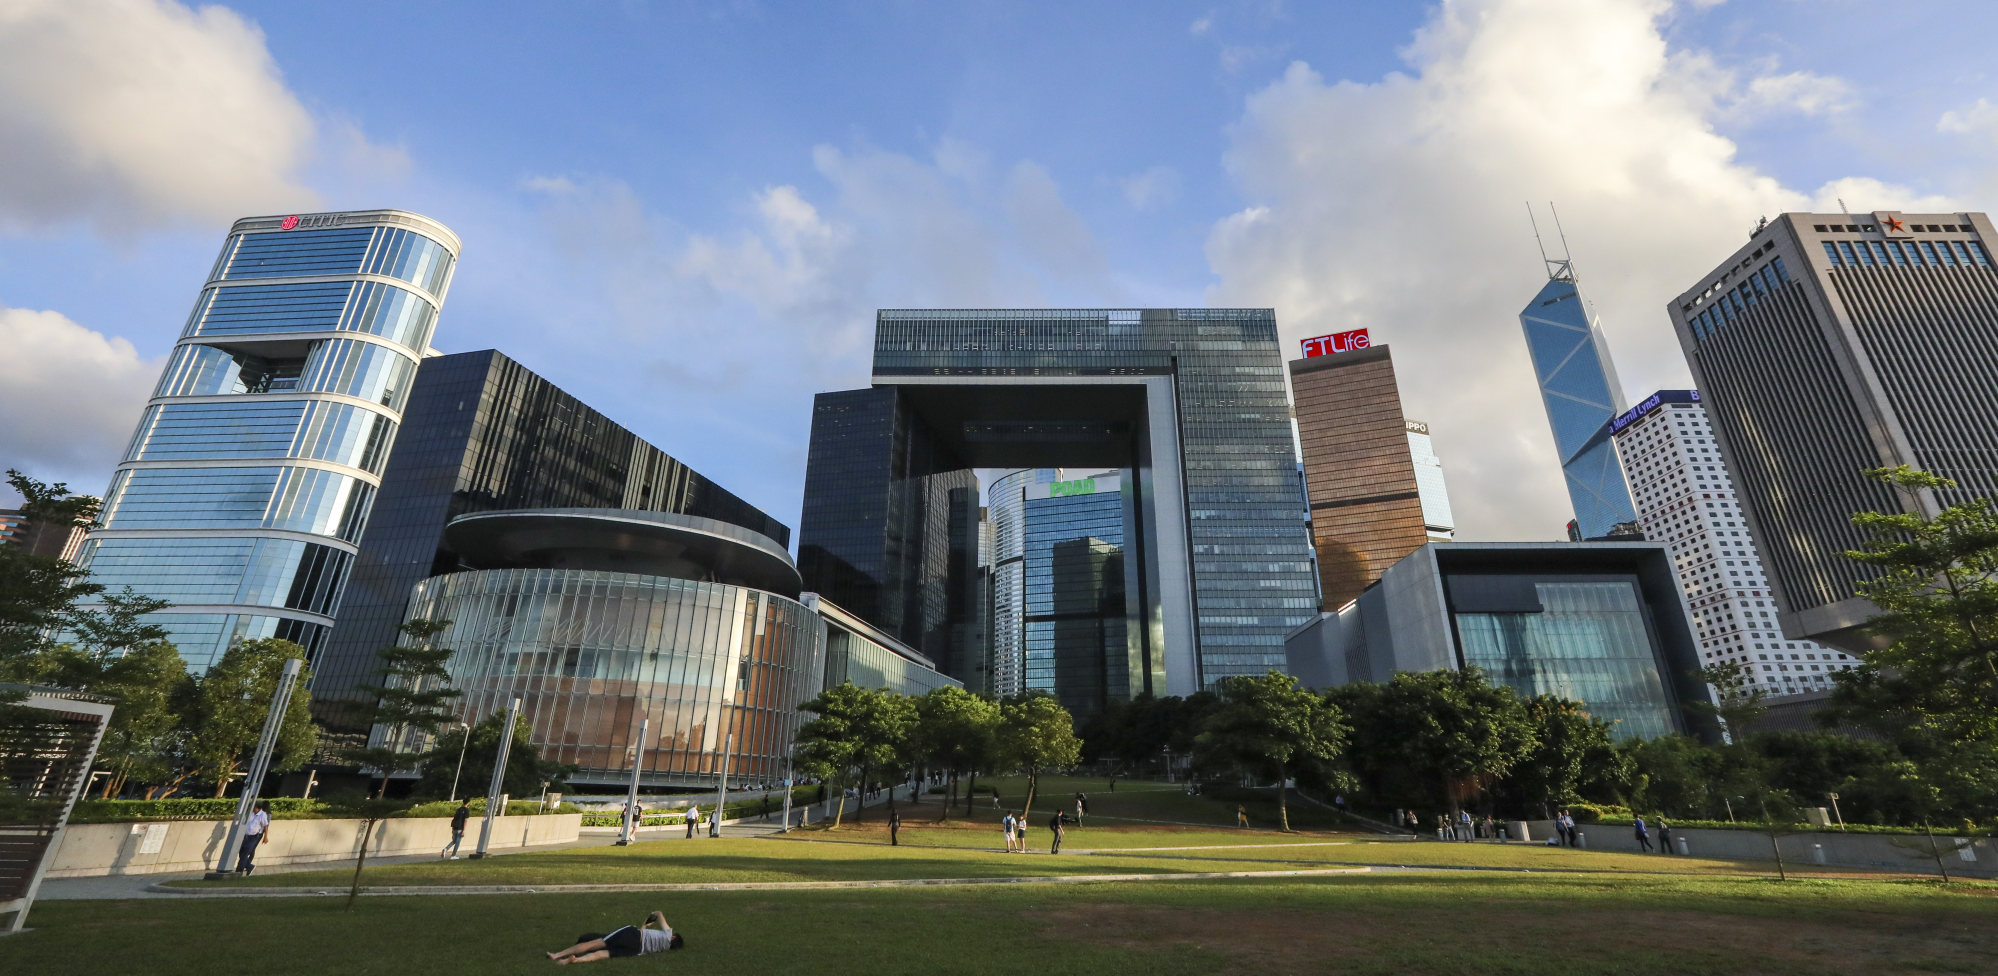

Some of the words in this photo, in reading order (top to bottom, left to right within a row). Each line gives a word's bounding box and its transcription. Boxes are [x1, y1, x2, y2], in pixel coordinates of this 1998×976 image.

[299, 214, 343, 228] CITIC
[1302, 332, 1369, 359] FTLife
[1613, 408, 1638, 430] Merrill
[1636, 394, 1660, 415] Lynch
[1405, 421, 1426, 432] IPPO
[1050, 478, 1095, 498] POAD
